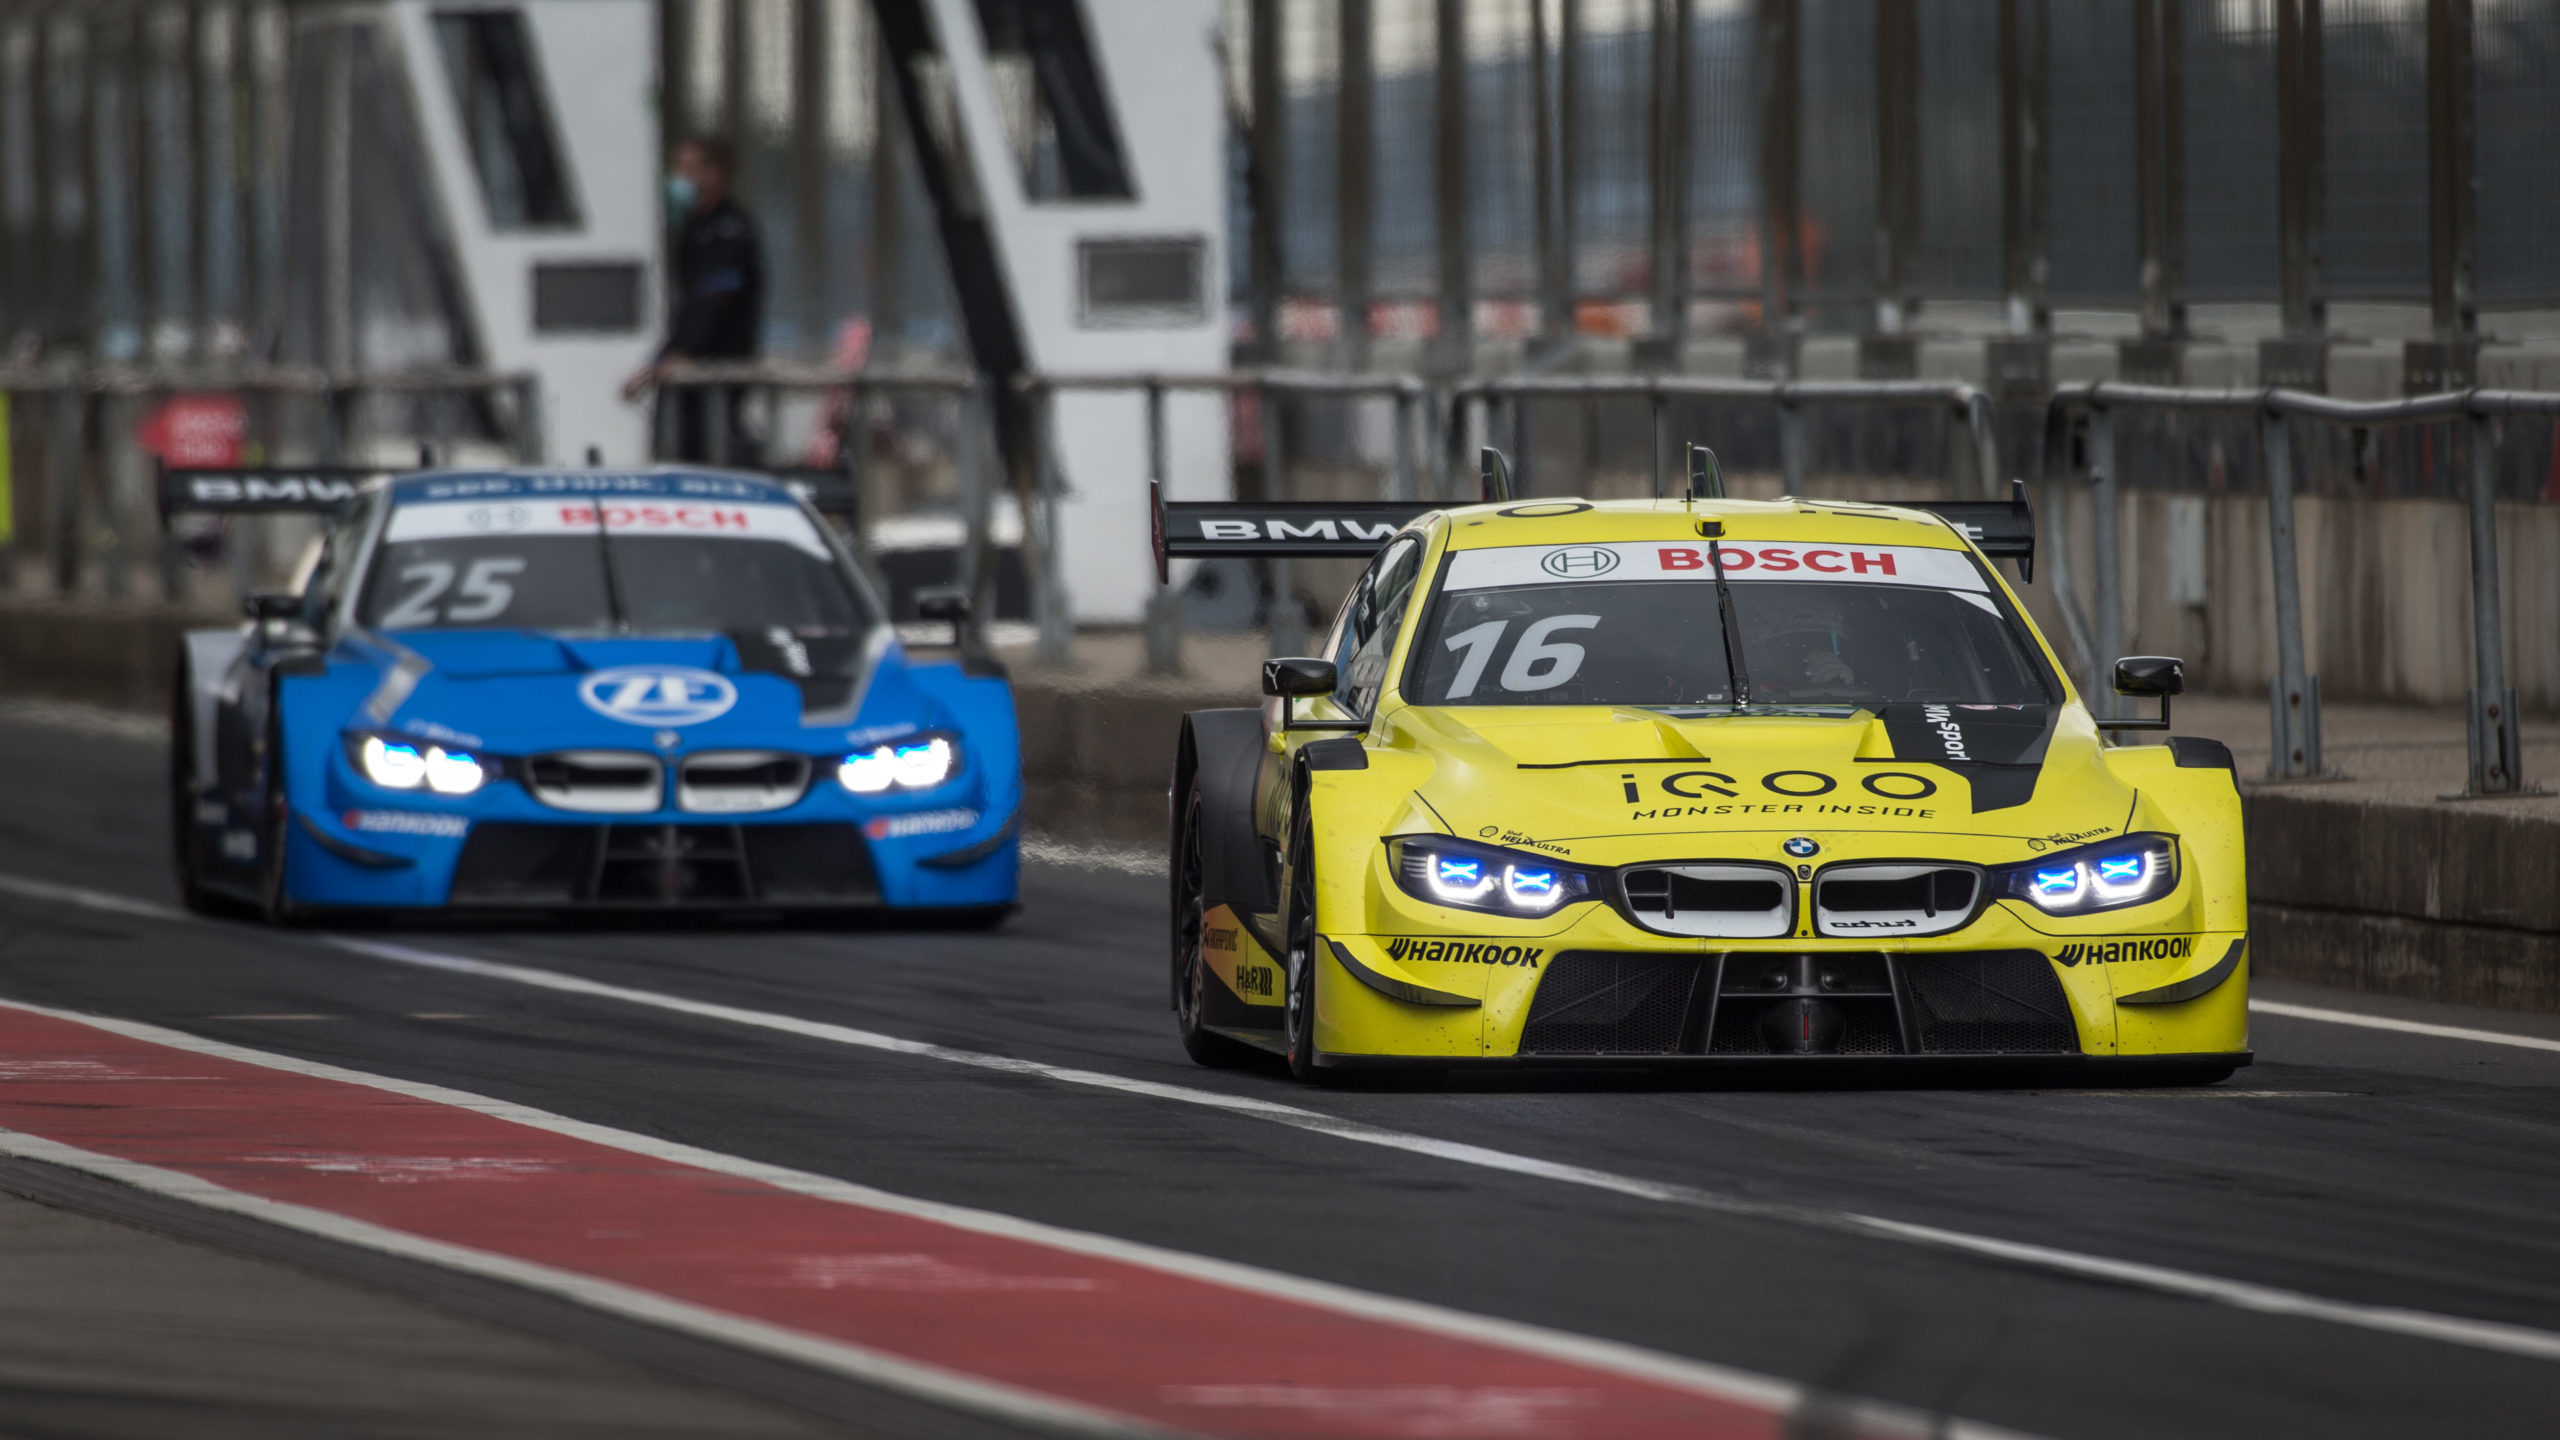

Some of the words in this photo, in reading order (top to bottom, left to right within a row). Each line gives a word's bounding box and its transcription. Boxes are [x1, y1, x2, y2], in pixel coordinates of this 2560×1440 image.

[559, 506, 749, 530] BOSCH
[1200, 520, 1400, 540] BMW
[1658, 548, 1898, 576] BOSCH
[380, 556, 527, 628] 25
[1445, 614, 1602, 700] 16
[1632, 803, 1804, 820] MONSTER
[1818, 804, 1937, 819] INSIDE
[1537, 842, 1571, 856] ULTRA
